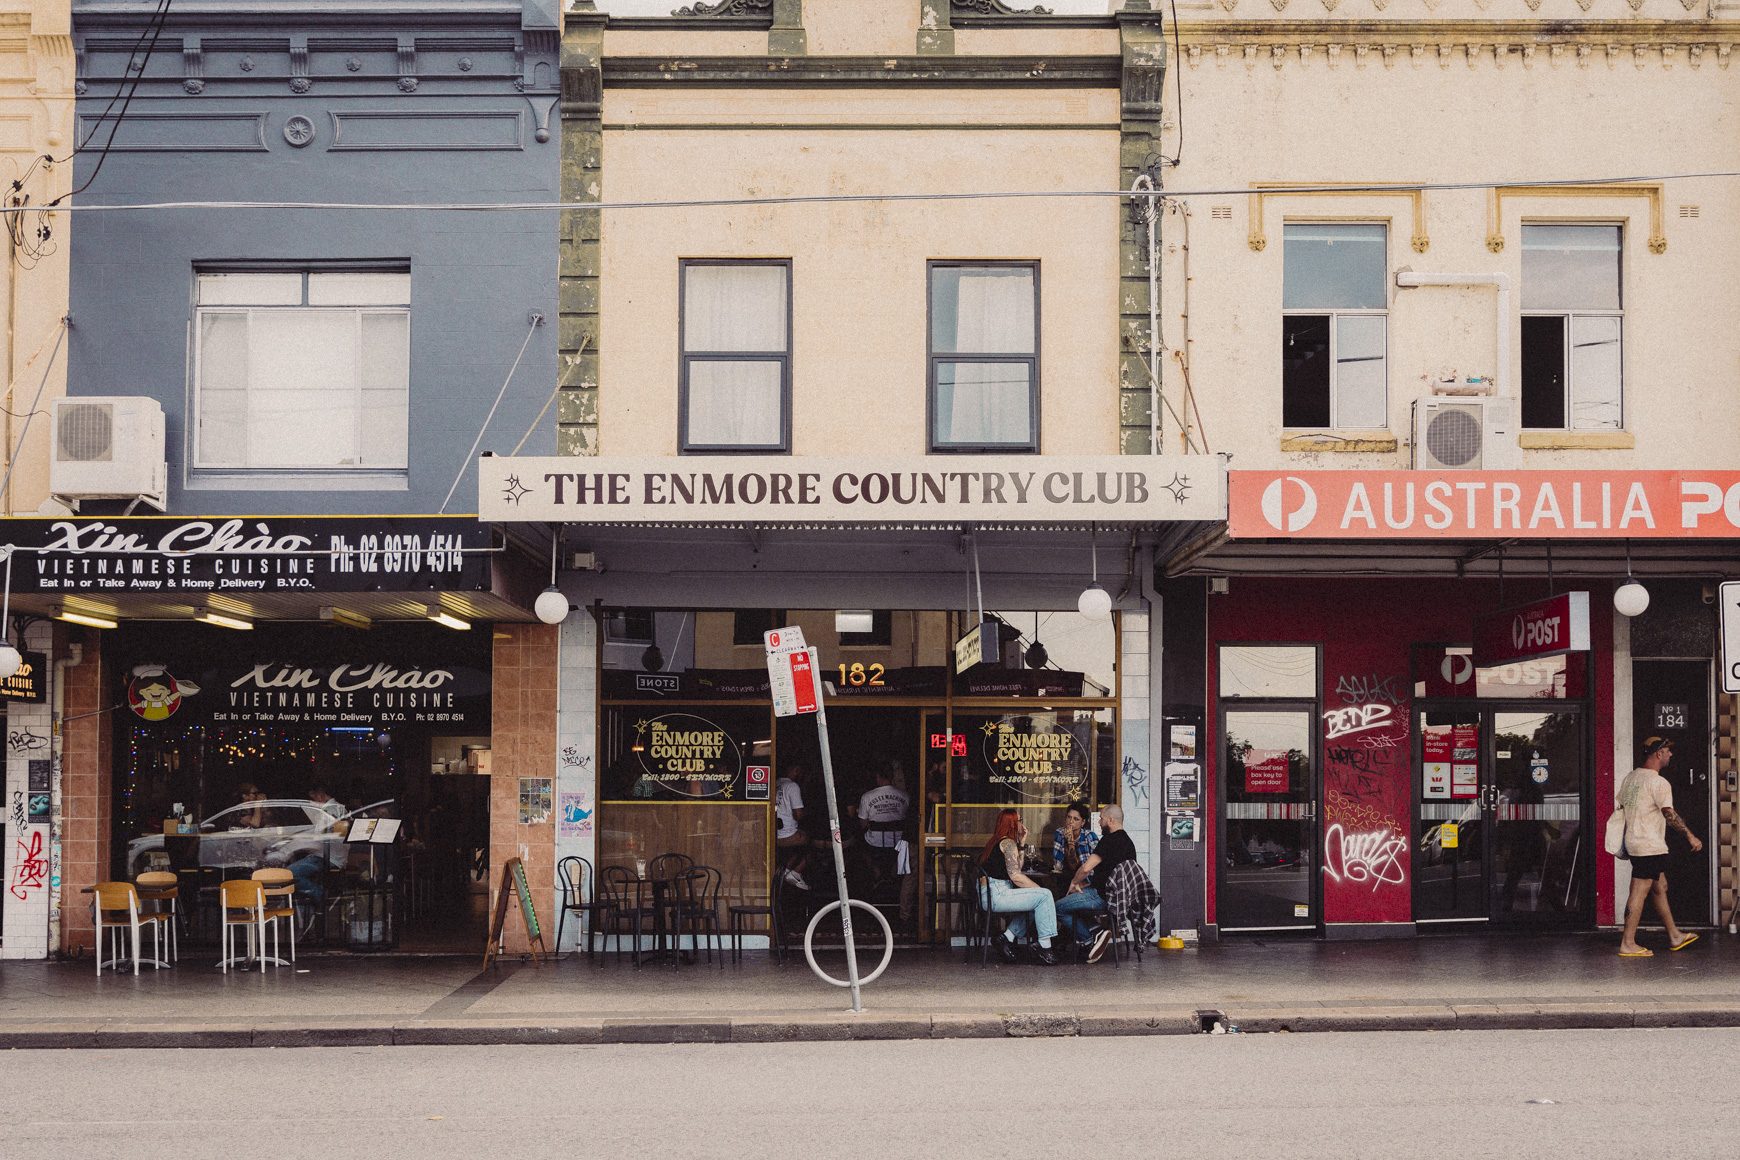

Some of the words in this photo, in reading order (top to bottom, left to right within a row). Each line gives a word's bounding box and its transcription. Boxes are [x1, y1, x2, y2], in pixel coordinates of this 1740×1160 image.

[544, 473, 631, 504] THE
[643, 473, 821, 504] ENMORE
[832, 472, 1035, 504] COUNTRY
[1042, 472, 1149, 504] CLUB
[1340, 481, 1656, 530] AUSTRALIA
[37, 521, 149, 555] Xin
[157, 518, 312, 557] Chào
[330, 535, 354, 573] Ph:
[360, 534, 378, 573] 02
[384, 534, 421, 573] 8970
[426, 534, 463, 573] 4514
[37, 559, 192, 574] VIETNAMESE
[215, 558, 315, 574] CUISINE
[39, 578, 59, 588] Eat
[63, 578, 75, 588] In
[80, 580, 93, 588] or
[98, 578, 126, 588] Take
[130, 578, 162, 589] Away
[167, 578, 177, 588] &
[181, 578, 215, 588] Home
[220, 578, 266, 589] Delivery
[277, 578, 313, 588] B.Y.O.
[1527, 616, 1561, 648] POST
[230, 661, 320, 688] Xin
[838, 662, 885, 686] 182
[8, 676, 33, 690] CUISINE
[230, 692, 353, 708] VIETNAMESE
[373, 693, 454, 708] CUISINE
[213, 712, 227, 720] Eat
[230, 712, 239, 720] In
[255, 712, 275, 720] Take
[277, 713, 300, 722] Away
[340, 713, 373, 722] Delivery
[381, 713, 407, 721] B.Y.O.
[427, 713, 435, 721] 02
[436, 713, 450, 721] 8970
[451, 713, 465, 721] 4514
[1658, 714, 1685, 728] 184
[651, 721, 668, 731] The
[651, 731, 724, 746] ENMORE
[998, 733, 1072, 748] ENMORE
[650, 745, 724, 758] COUNTRY
[997, 747, 1072, 761] COUNTRY
[667, 759, 706, 772] CLUB
[1014, 761, 1053, 774] CLUB
